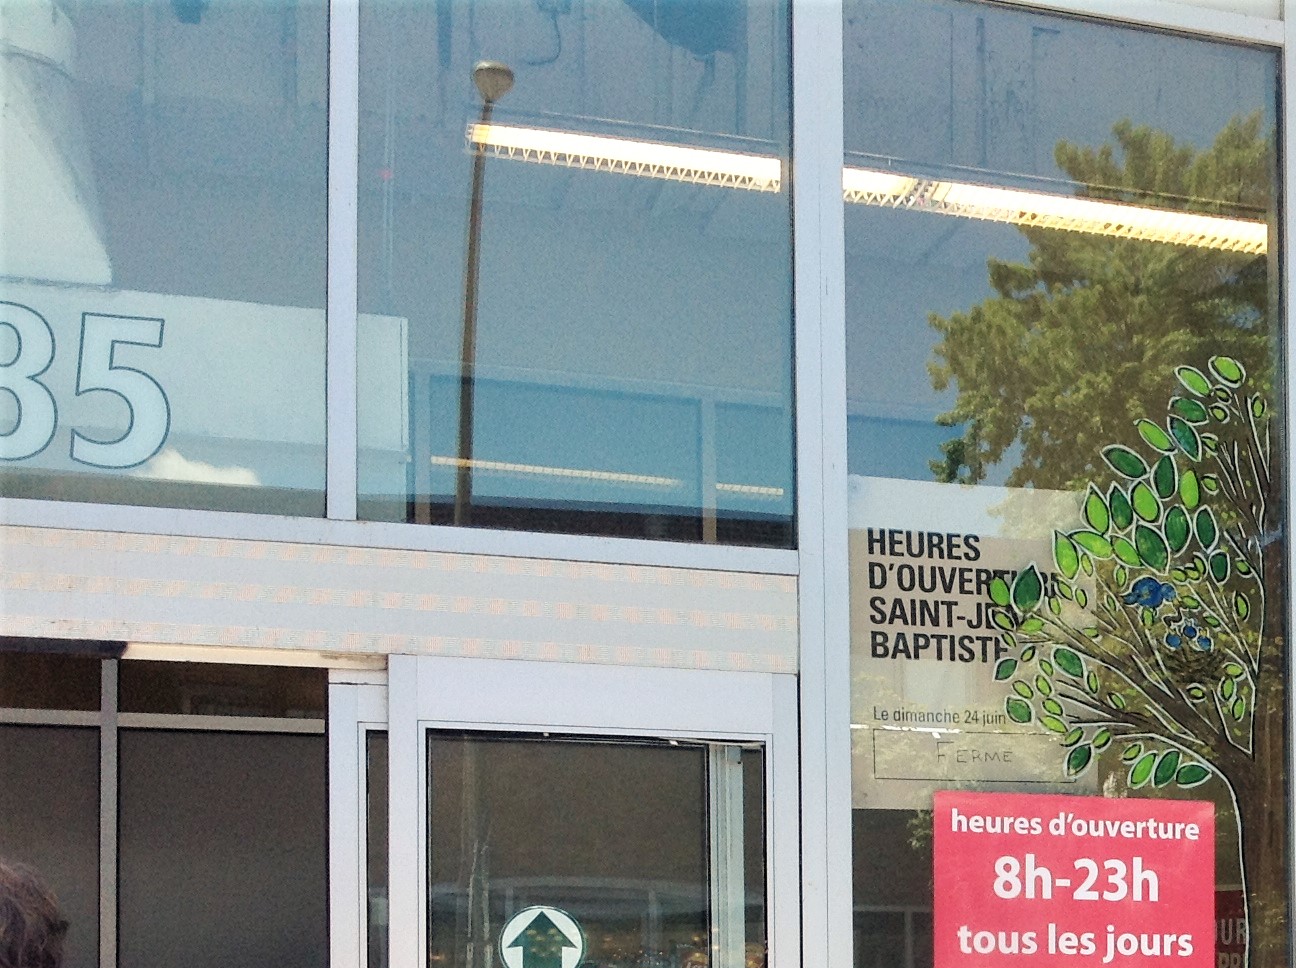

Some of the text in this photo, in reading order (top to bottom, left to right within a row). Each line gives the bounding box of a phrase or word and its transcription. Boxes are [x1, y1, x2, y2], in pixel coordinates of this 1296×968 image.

[867, 527, 981, 562] HEURES
[868, 562, 1060, 597] D'OUVER
[869, 596, 1020, 630] SAINT-JE
[873, 705, 1007, 727] Le dimanche 24 juin
[951, 808, 1200, 840] heures d'ouverture
[993, 853, 1160, 902] 8h-23h
[958, 923, 1194, 963] tous les jours
